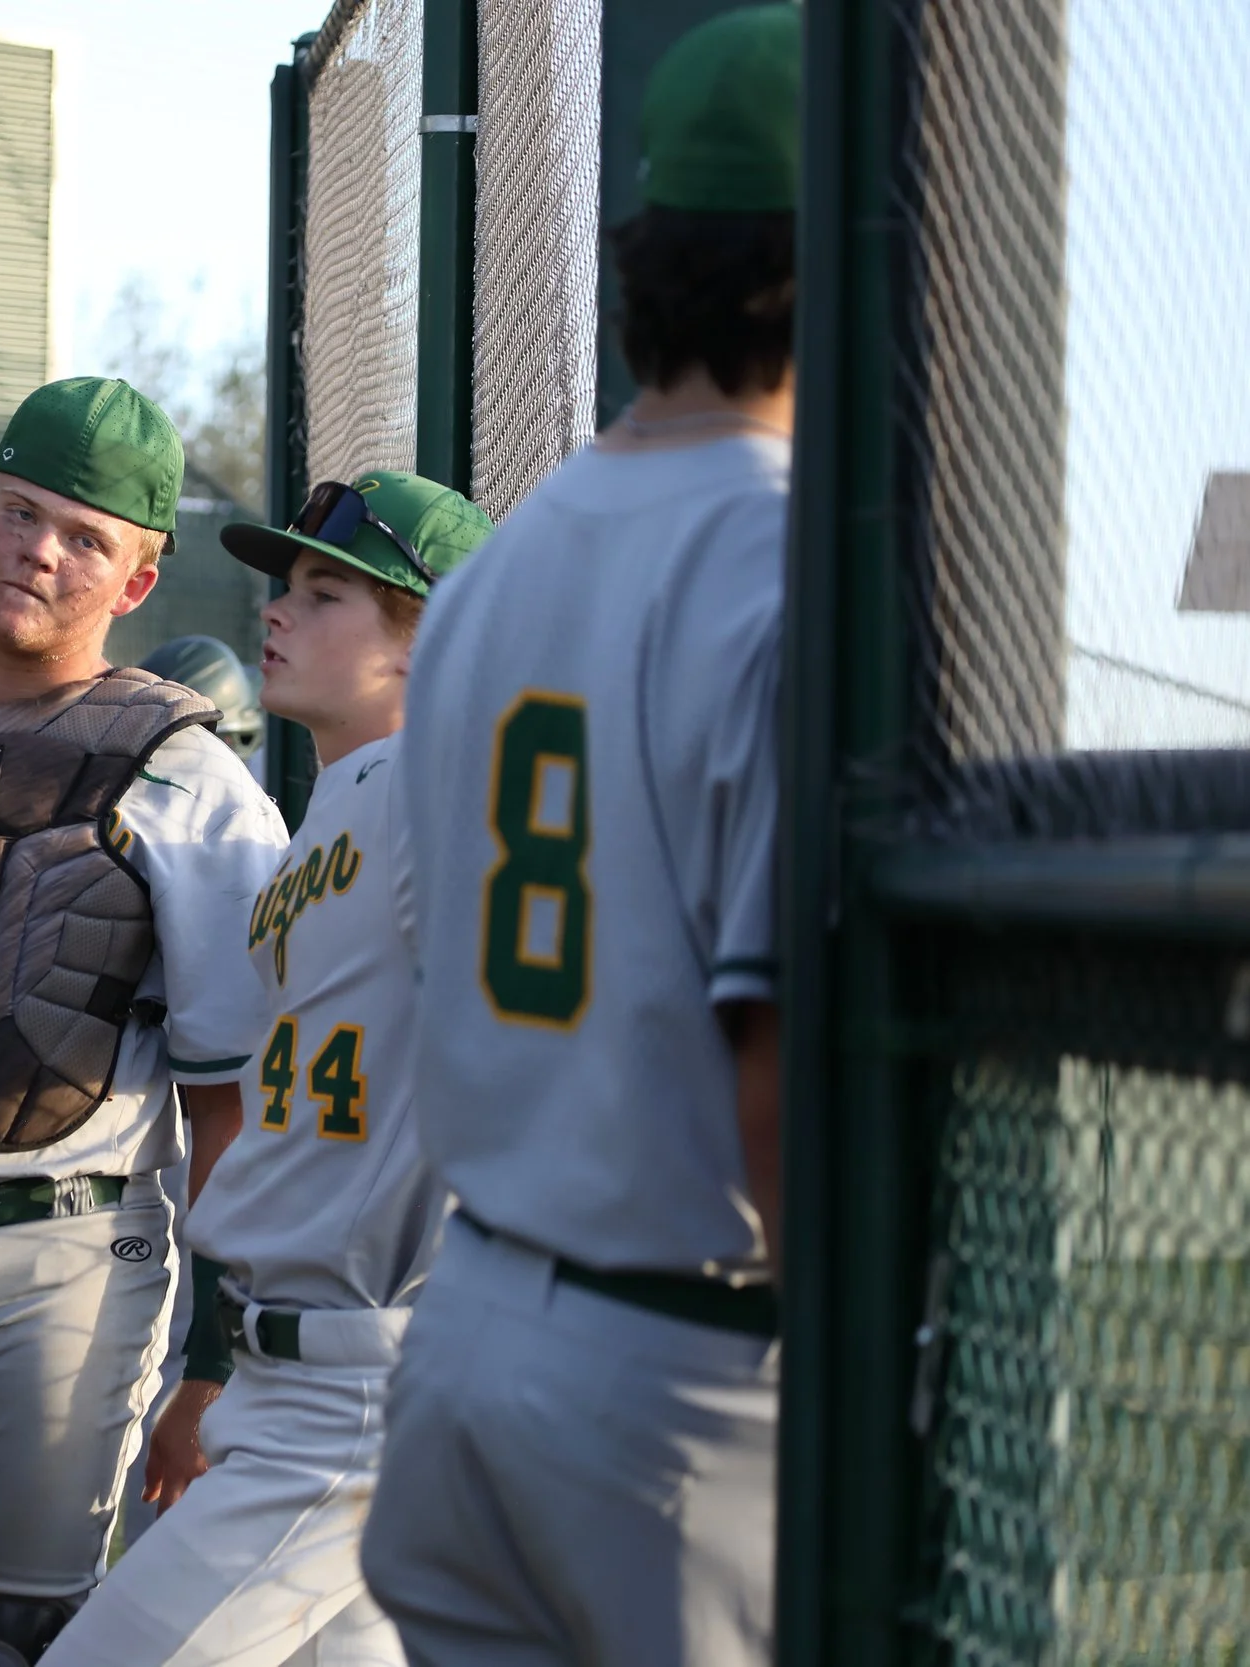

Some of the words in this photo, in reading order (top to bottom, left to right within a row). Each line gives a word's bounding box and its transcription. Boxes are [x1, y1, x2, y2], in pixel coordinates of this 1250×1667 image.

[248, 831, 363, 990] izon
[479, 687, 593, 1035] 8
[260, 1014, 369, 1142] 44
[115, 1238, 148, 1259] R
